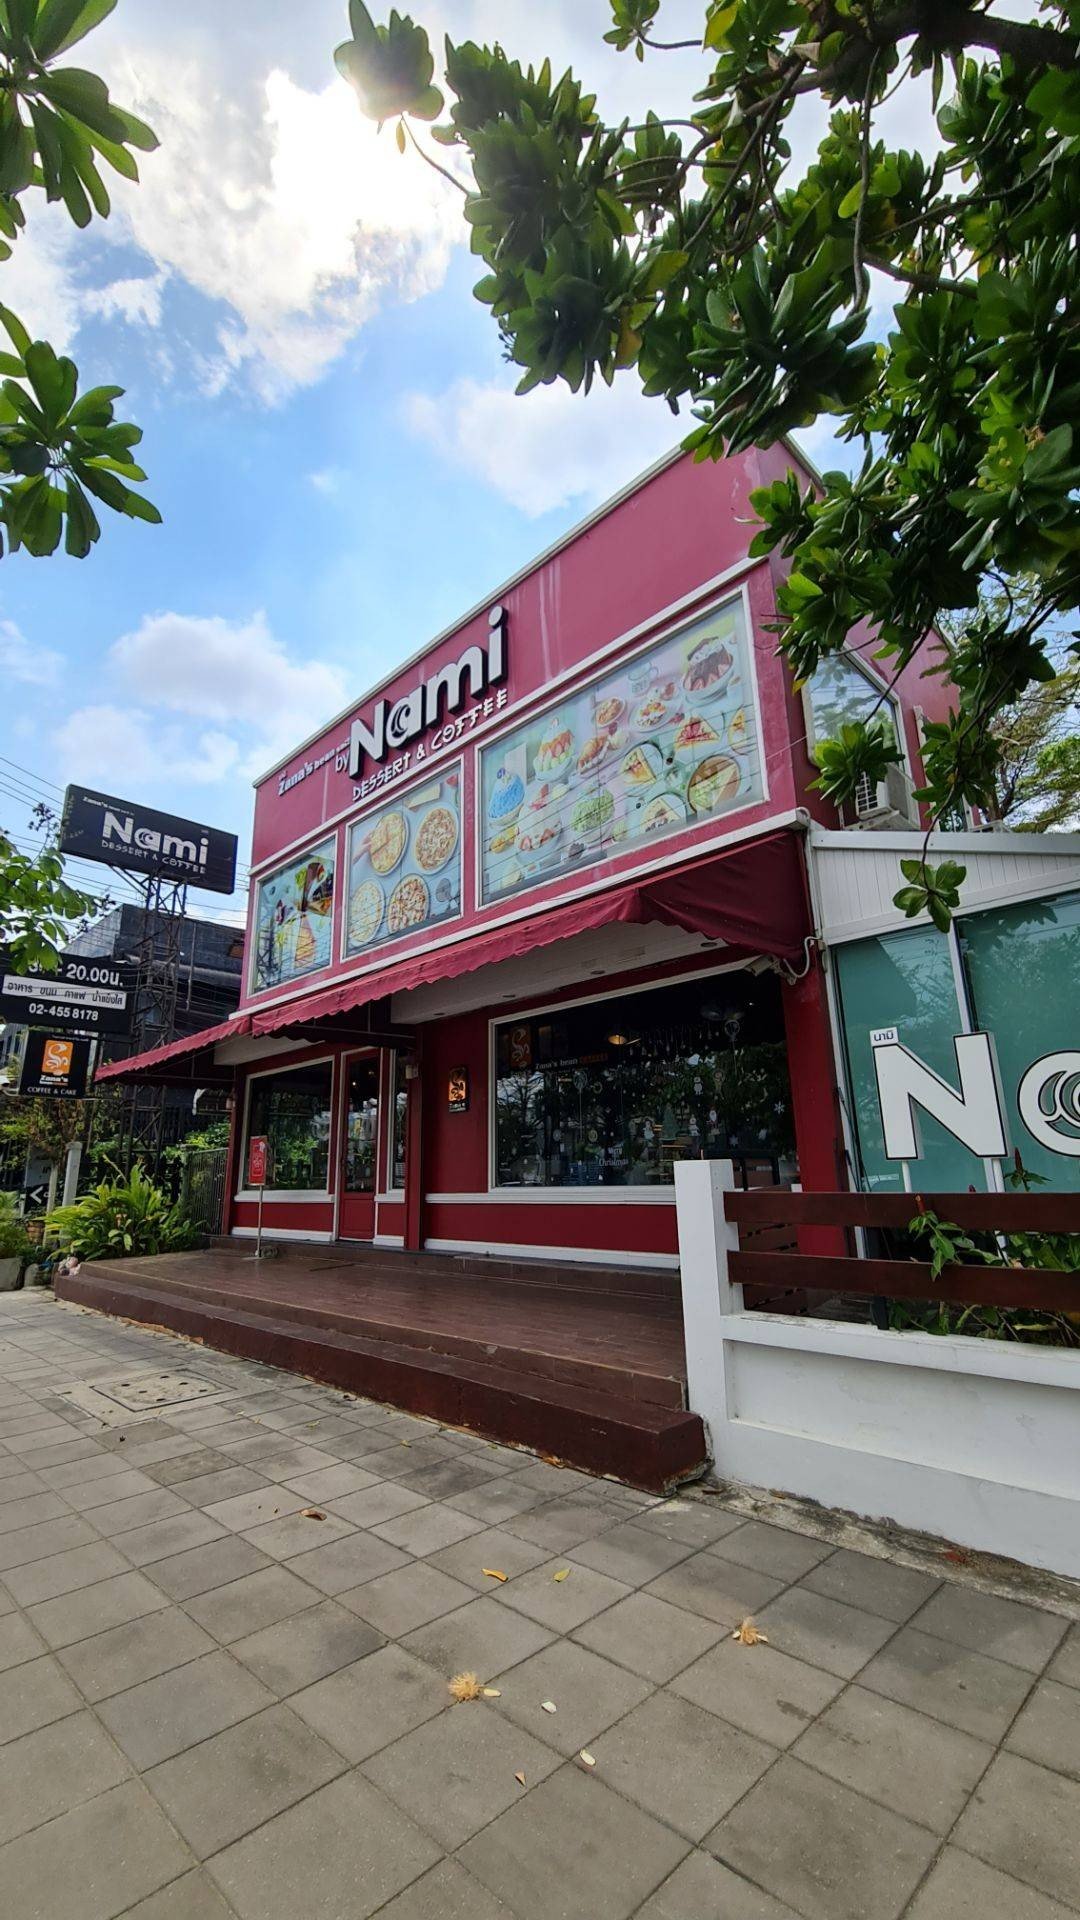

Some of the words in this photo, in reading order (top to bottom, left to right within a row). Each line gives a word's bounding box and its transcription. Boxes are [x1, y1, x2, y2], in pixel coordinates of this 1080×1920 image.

[349, 605, 507, 779] Nami
[416, 743, 426, 761] &
[431, 688, 508, 751] COFFEE
[335, 751, 350, 773] by
[102, 811, 209, 865] Nami
[101, 839, 149, 862] DESSERT
[162, 856, 207, 875] COFFEE
[7, 982, 33, 993] อาหาร
[39, 987, 57, 997] ขนม
[64, 990, 87, 1000] กาแฟ
[28, 1003, 71, 1018] 02-455
[72, 1008, 99, 1021] 8178
[27, 1086, 52, 1095] COFFEE
